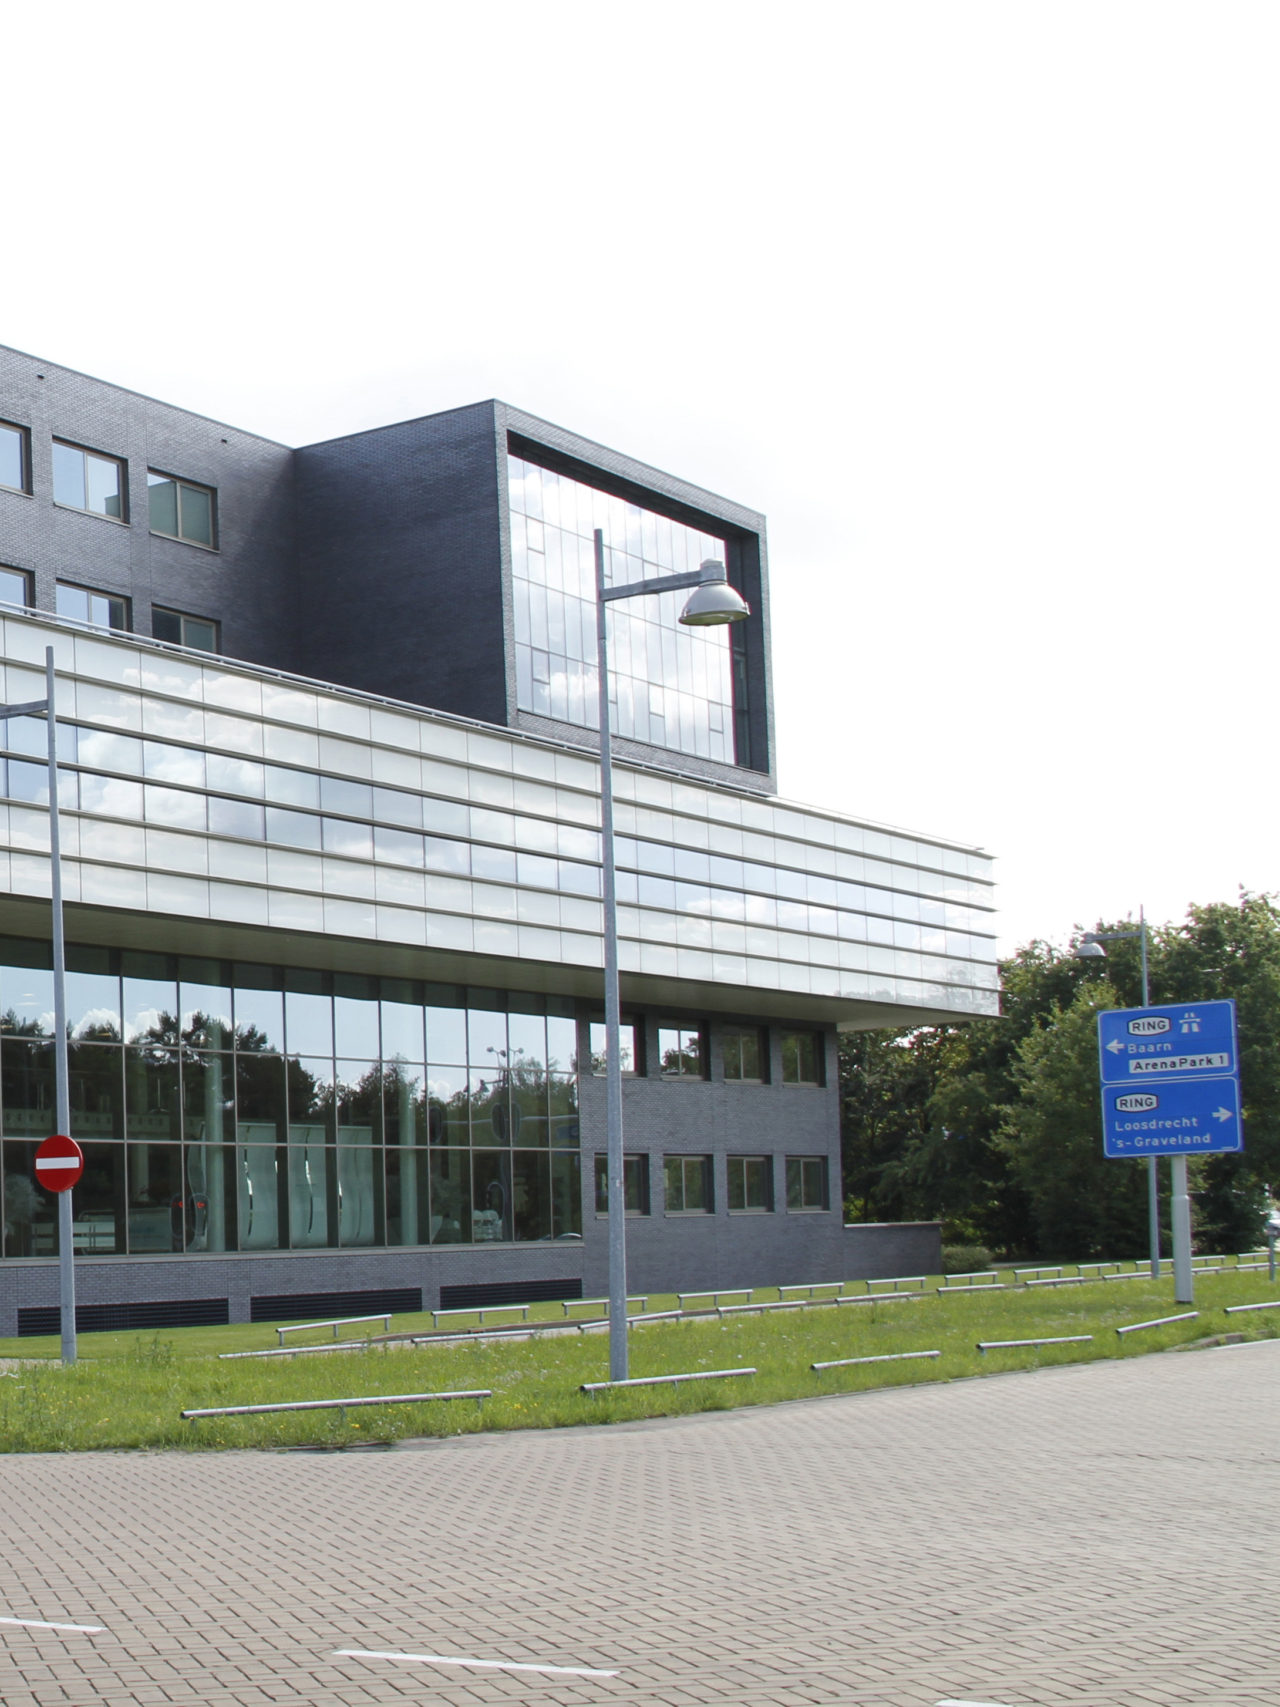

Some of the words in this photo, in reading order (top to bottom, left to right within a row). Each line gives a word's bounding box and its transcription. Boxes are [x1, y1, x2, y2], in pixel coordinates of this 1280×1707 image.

[1131, 1020, 1167, 1032] RING
[1128, 1042, 1172, 1054] Baarn
[1133, 1056, 1214, 1071] ArenaPark
[1119, 1096, 1154, 1109] RING
[1114, 1117, 1198, 1131] Loosdrecht
[1112, 1133, 1211, 1148] 's-Graveland
